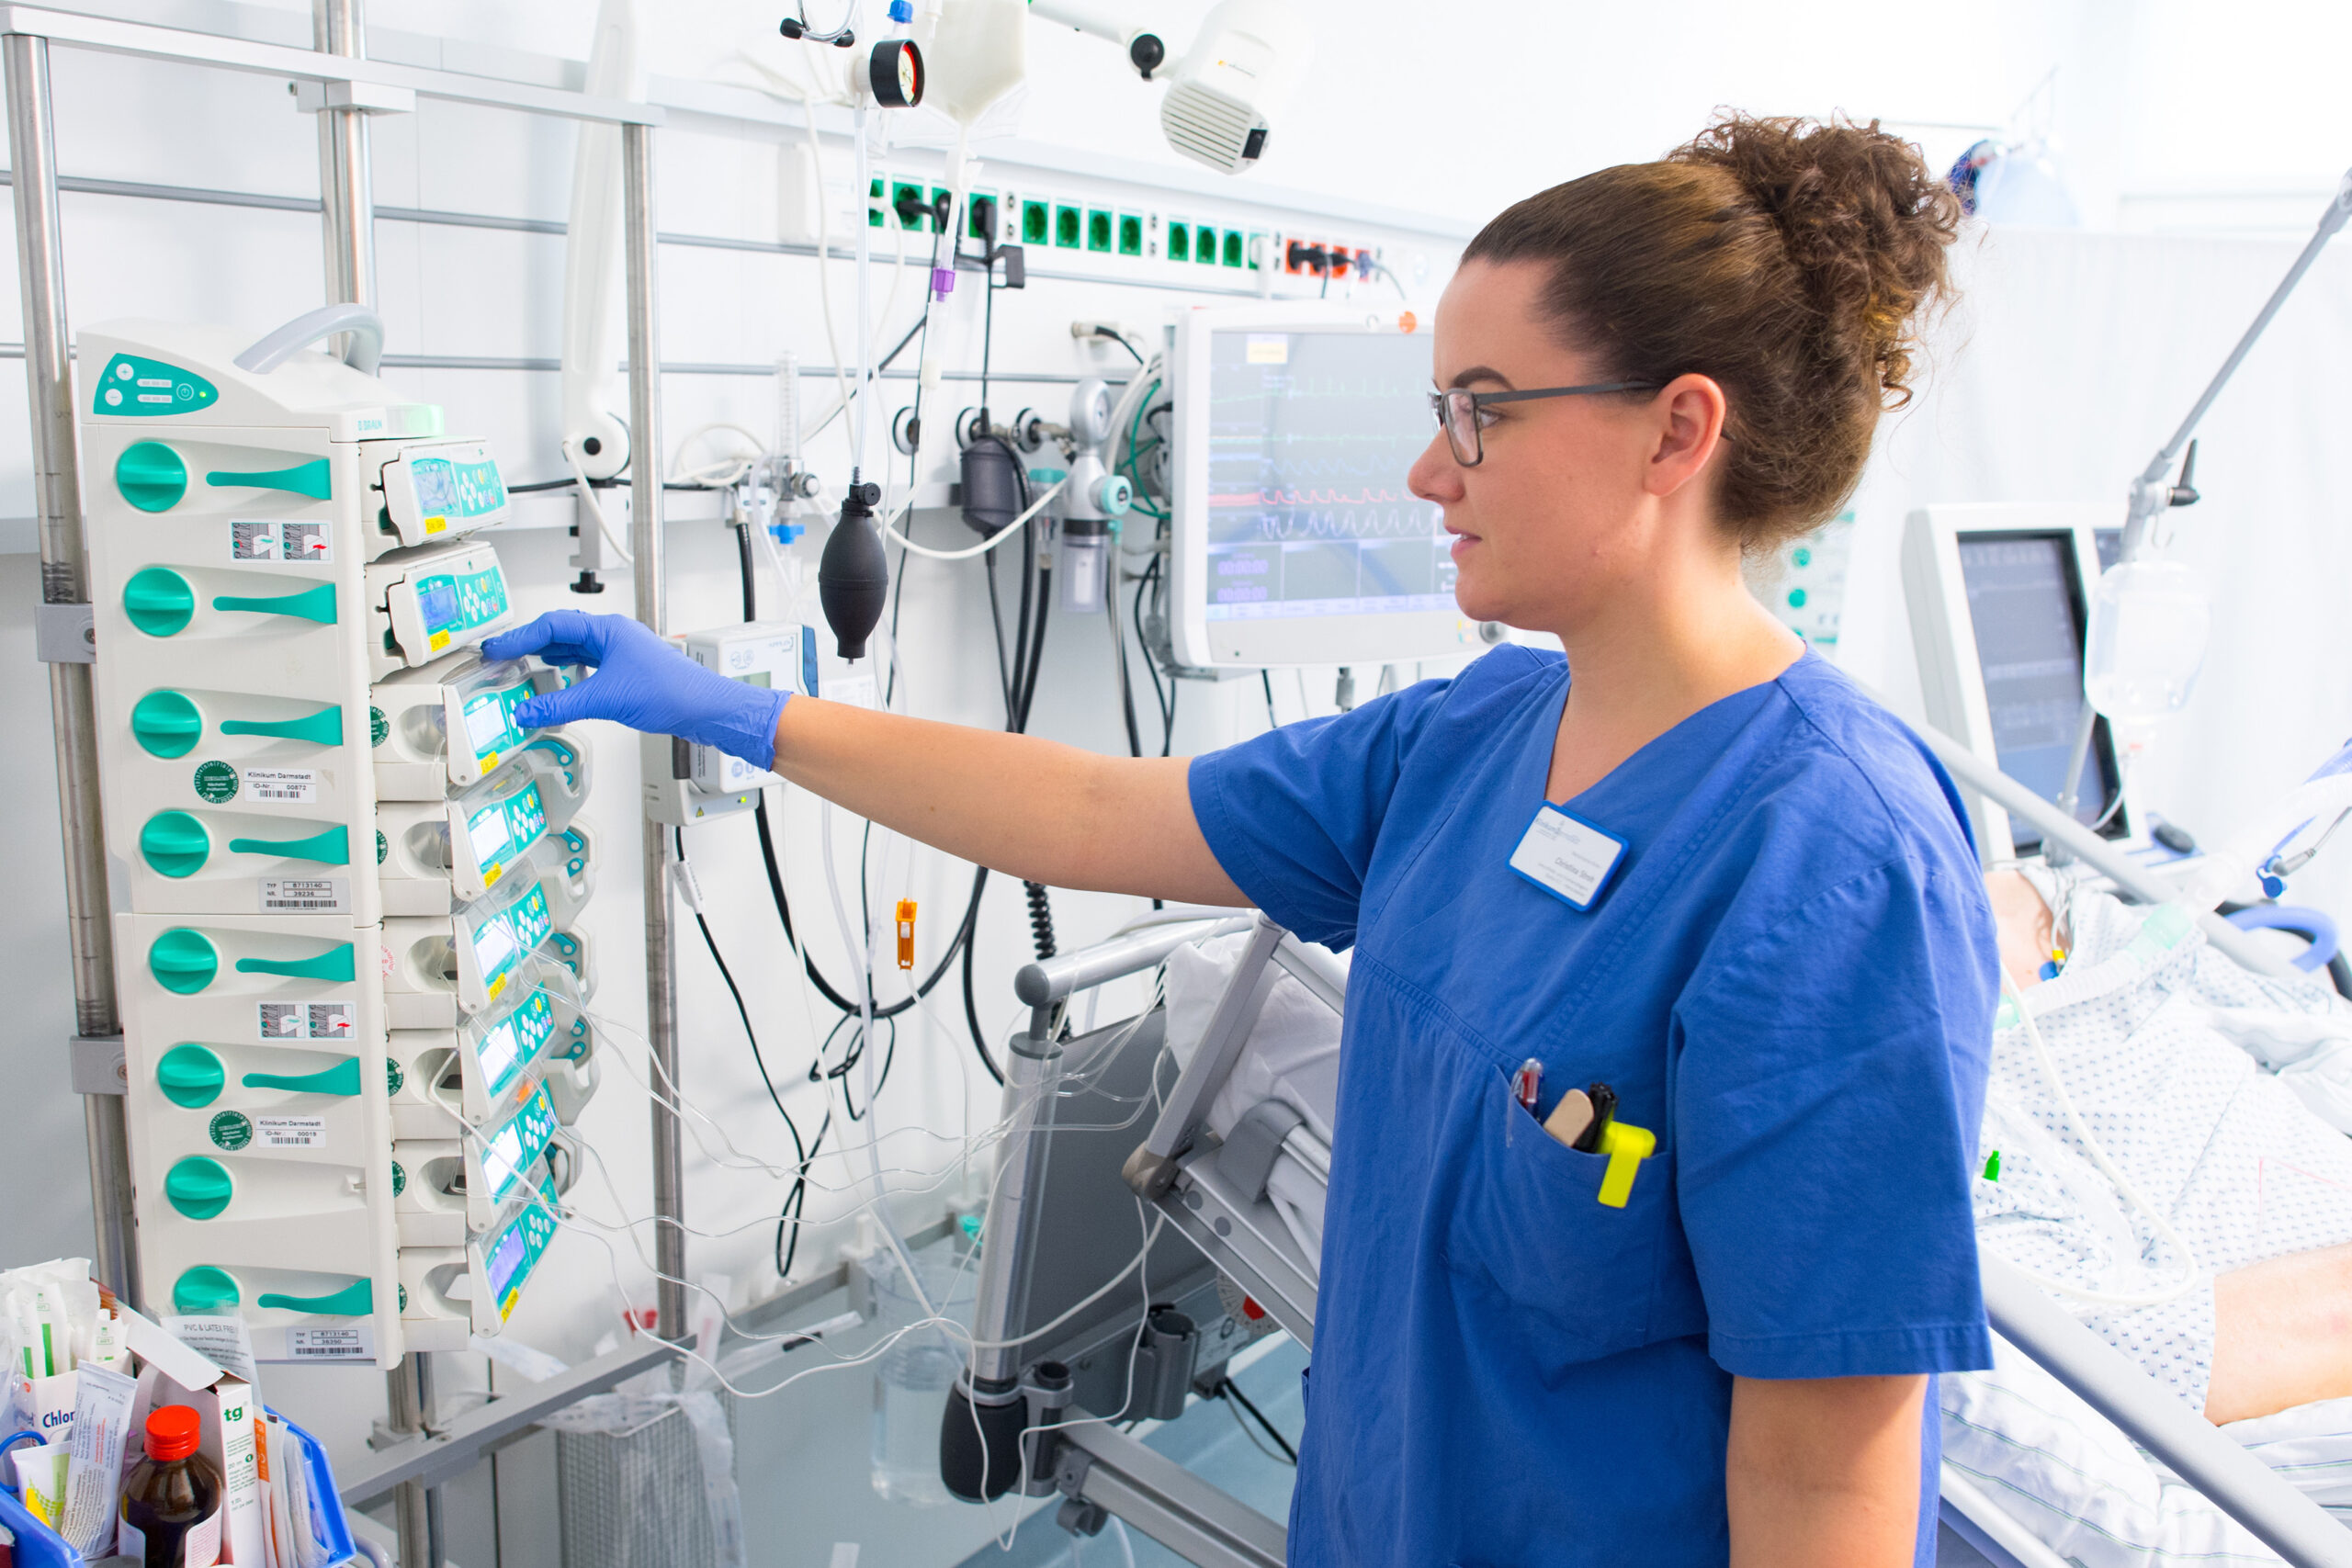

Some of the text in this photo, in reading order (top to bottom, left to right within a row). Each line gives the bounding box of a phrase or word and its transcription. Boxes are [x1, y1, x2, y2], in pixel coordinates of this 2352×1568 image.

[184, 1324, 198, 1332] PVC
[205, 1324, 222, 1332] LATEX
[42, 1409, 75, 1428] Chlor
[224, 1406, 243, 1422] tg
